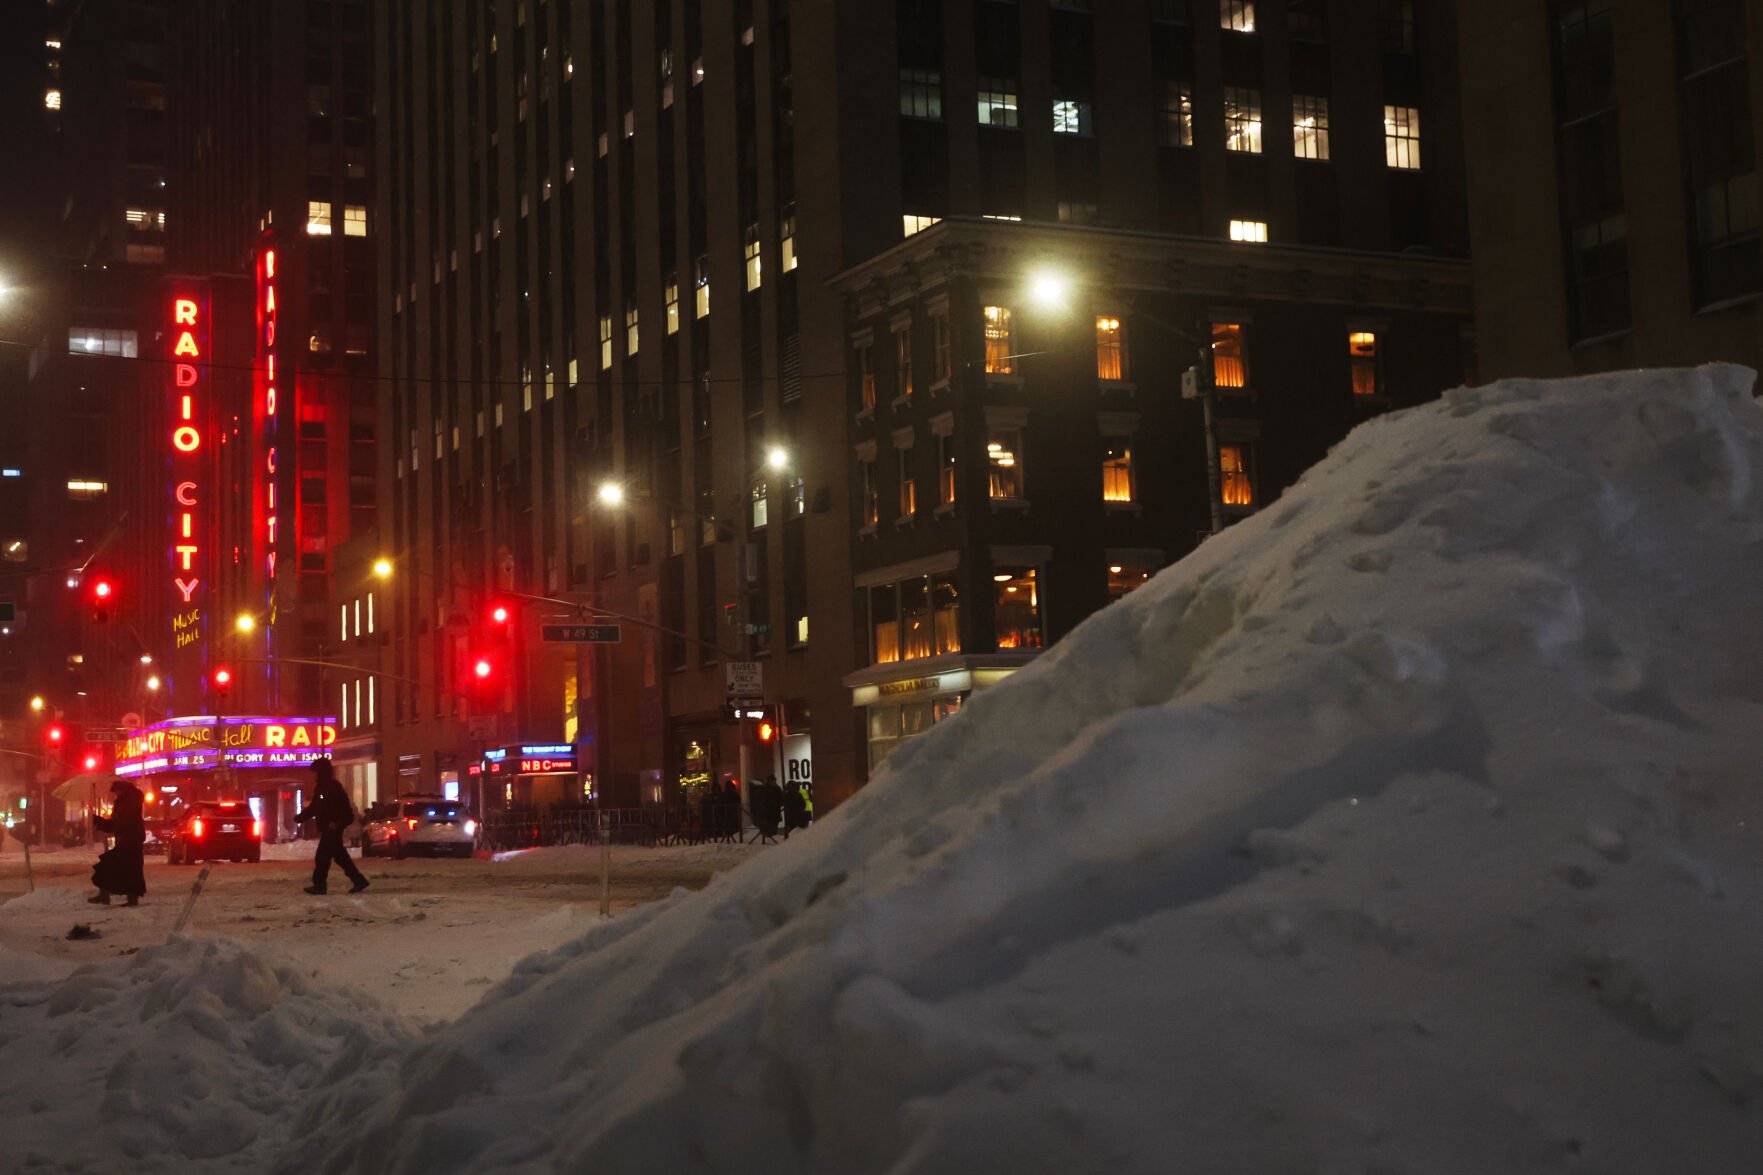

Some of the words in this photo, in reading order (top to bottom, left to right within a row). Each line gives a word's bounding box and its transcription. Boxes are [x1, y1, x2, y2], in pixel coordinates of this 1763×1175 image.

[266, 250, 276, 416] RADIO
[174, 299, 200, 452] RADIO
[268, 447, 277, 579] CITY
[174, 481, 199, 602] CITY
[148, 731, 165, 753] CITY
[265, 725, 336, 747] RAD
[174, 756, 189, 765] JAN
[193, 755, 205, 765] 25
[270, 753, 297, 762] ALAN
[522, 760, 551, 771] NBC
[789, 758, 810, 780] RO
